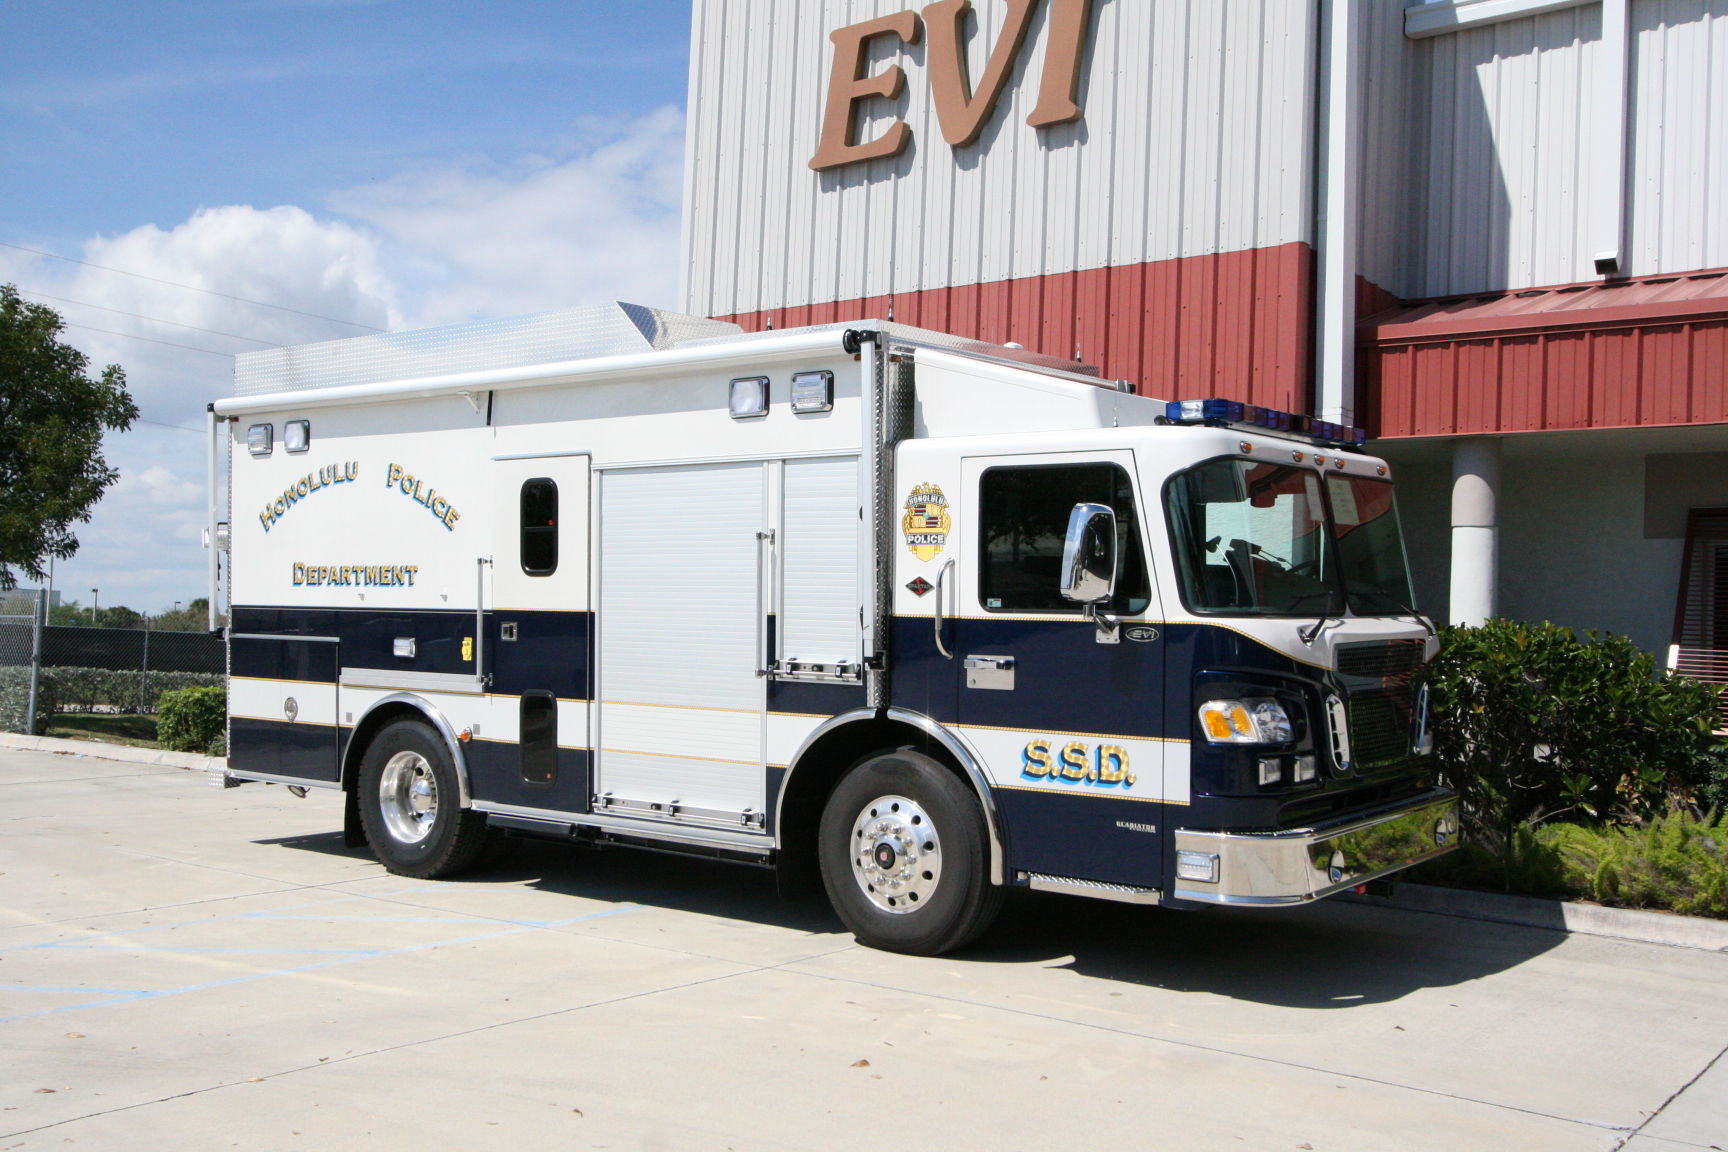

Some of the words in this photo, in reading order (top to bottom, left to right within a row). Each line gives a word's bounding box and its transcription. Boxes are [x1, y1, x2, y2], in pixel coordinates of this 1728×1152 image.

[808, 0, 1090, 172] EVI
[259, 462, 359, 534] HONOLULU
[386, 463, 461, 532] POLICE
[908, 494, 944, 505] HONOLULU
[907, 535, 944, 544] POLICE
[292, 562, 418, 587] DEPARTMENT
[1020, 739, 1137, 790] S.S.D.
[1116, 820, 1156, 831] GLADIATOR
